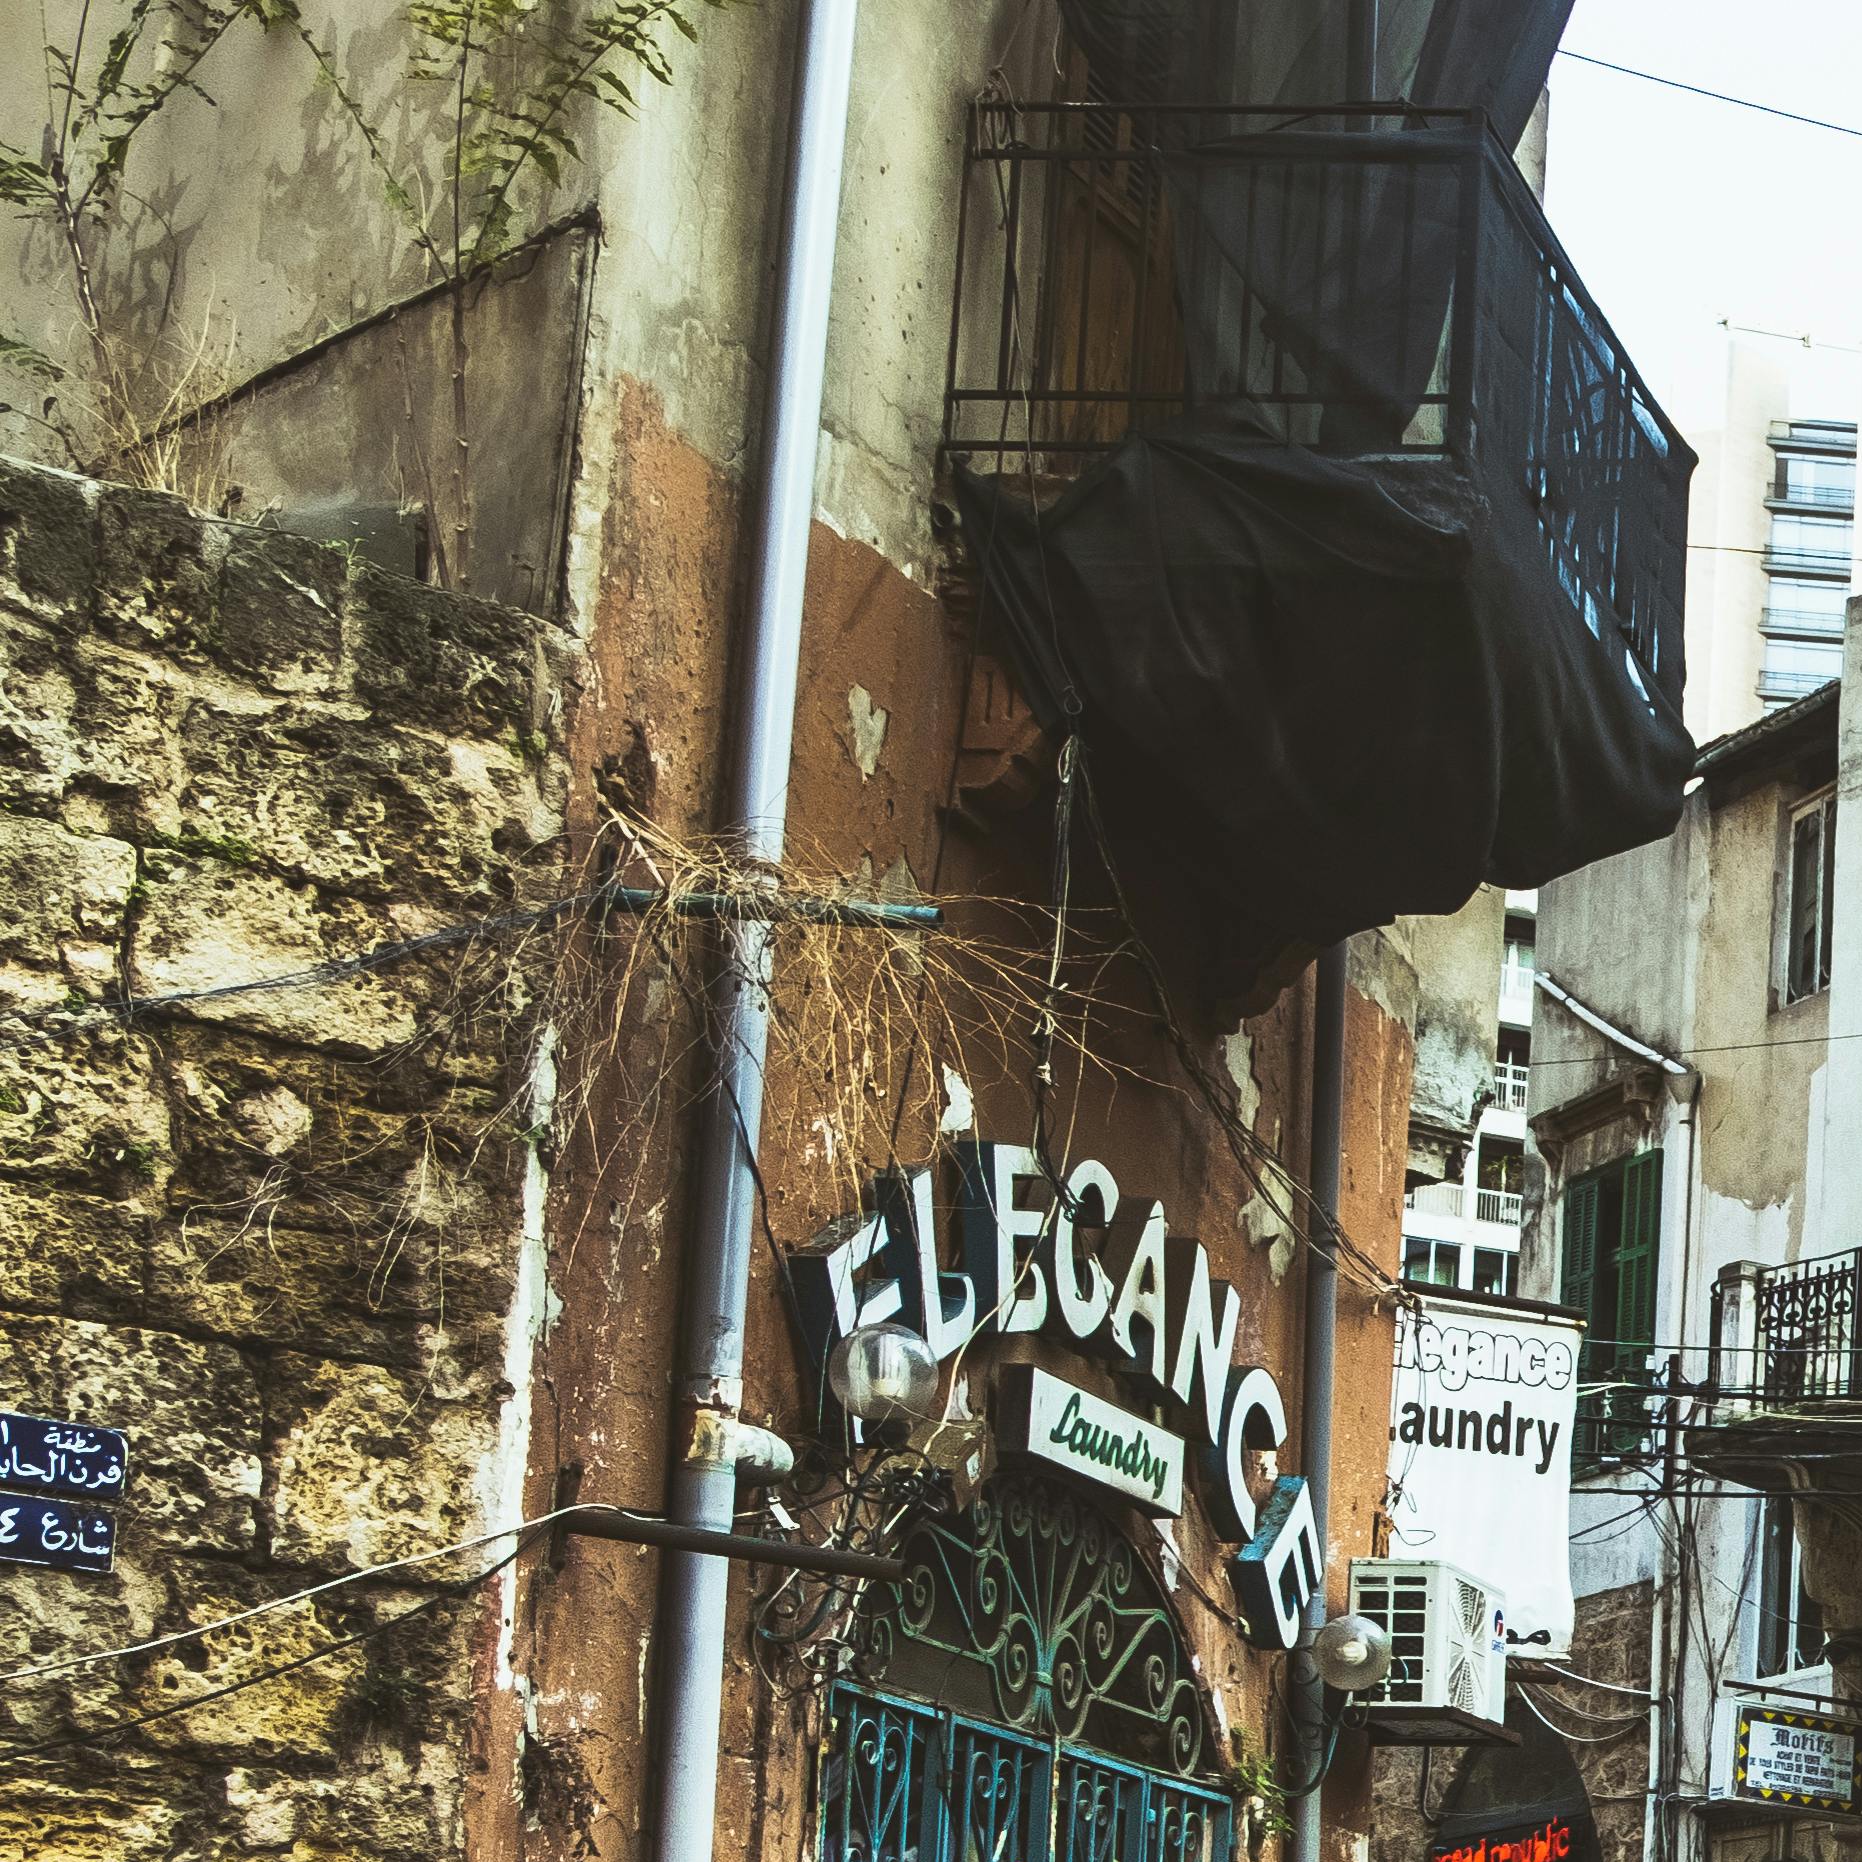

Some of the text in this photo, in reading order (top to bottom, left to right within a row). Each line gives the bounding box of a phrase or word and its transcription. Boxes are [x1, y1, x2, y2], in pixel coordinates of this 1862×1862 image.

[43, 1426, 102, 1454] منطقة
[1049, 1392, 1168, 1500] Laundry
[1389, 1400, 1560, 1475] aundry
[0, 1445, 122, 1489] فرن الحاي
[41, 1511, 110, 1555] شارع
[1770, 1727, 1834, 1756] Motifs
